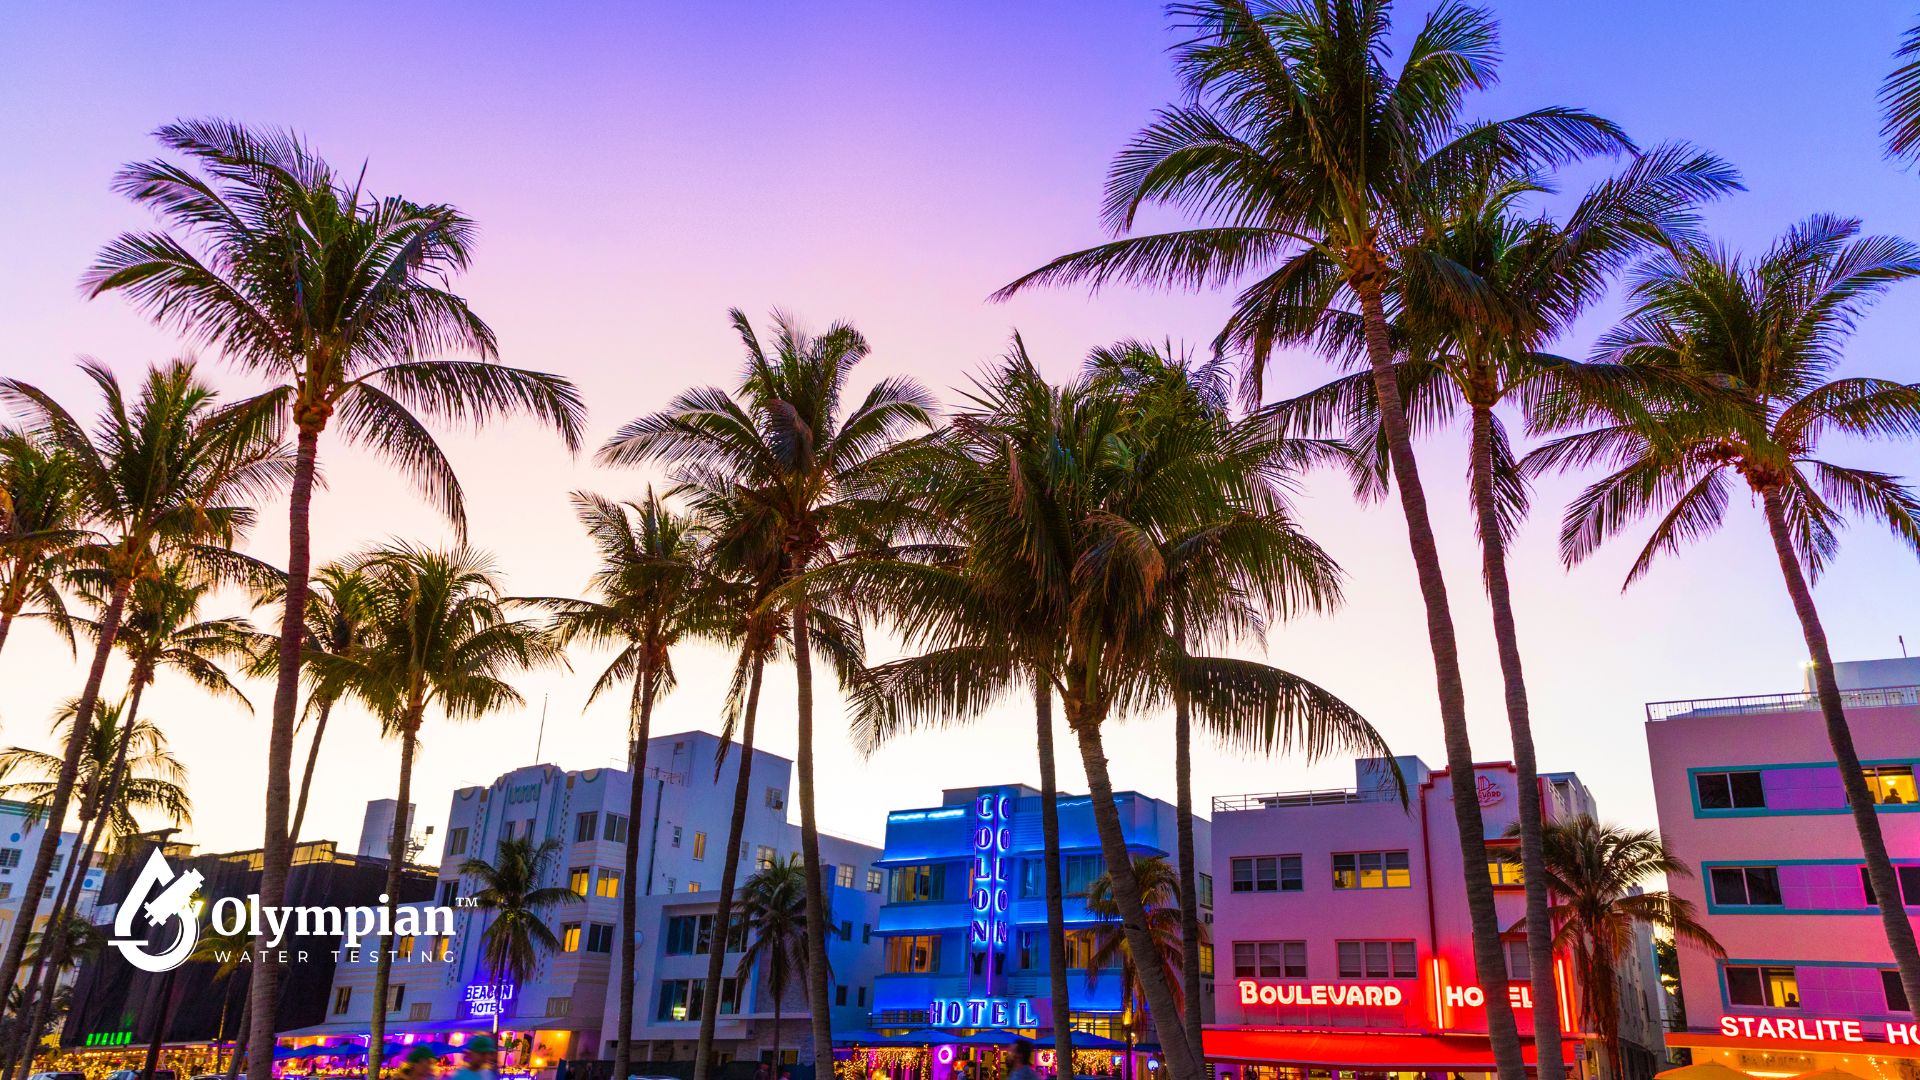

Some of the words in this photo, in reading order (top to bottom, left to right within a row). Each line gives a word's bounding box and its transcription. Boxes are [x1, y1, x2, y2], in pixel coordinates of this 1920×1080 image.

[970, 795, 993, 976] COLONY
[466, 985, 512, 1000] BEACN
[1445, 986, 1533, 1008] HOEL
[929, 1000, 1038, 1026] HOTEL
[1721, 1017, 1863, 1042] STARLITE
